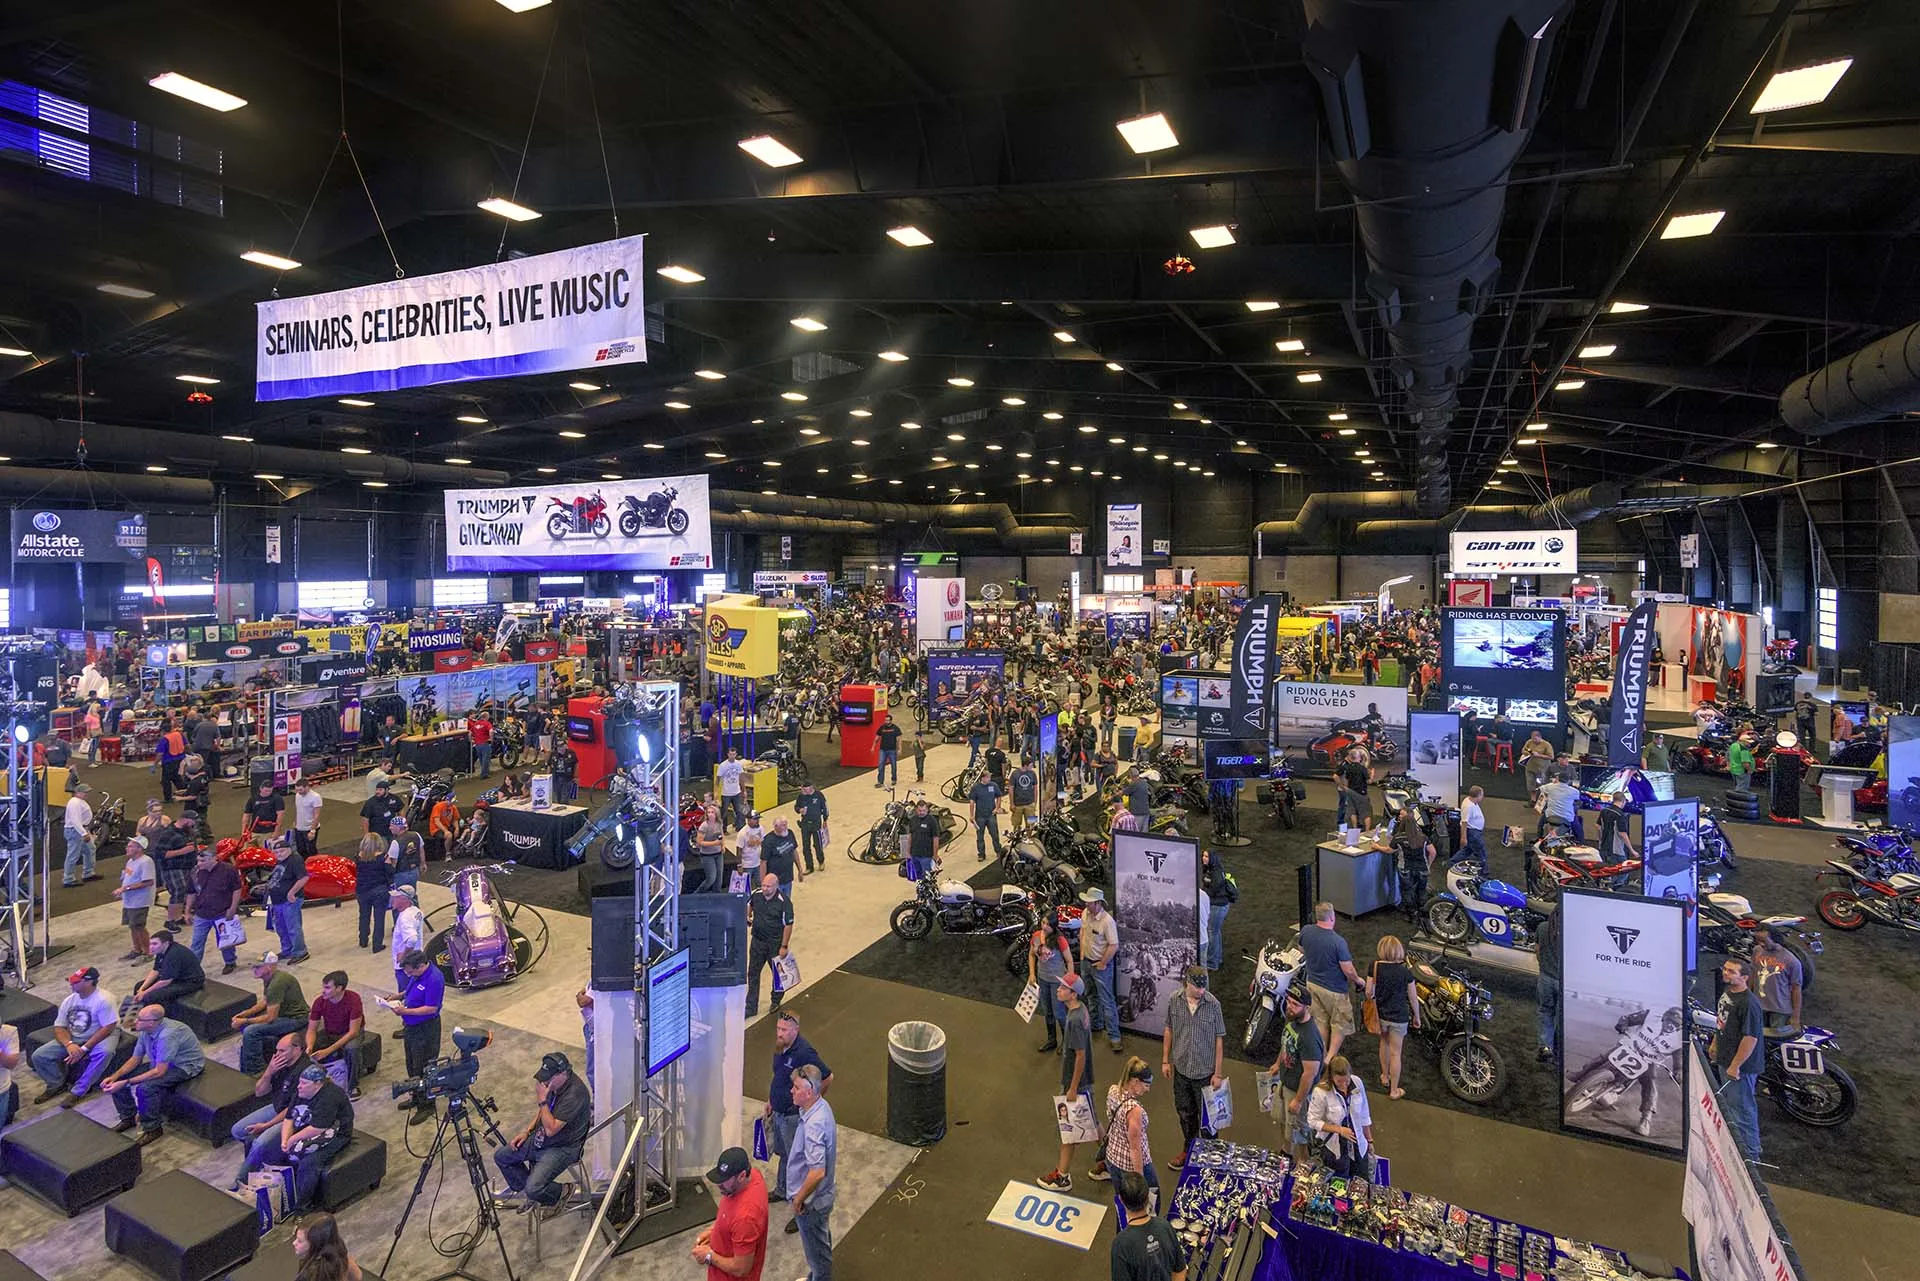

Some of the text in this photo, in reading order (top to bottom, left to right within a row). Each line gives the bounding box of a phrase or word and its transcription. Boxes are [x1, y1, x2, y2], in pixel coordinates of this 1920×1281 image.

[265, 268, 630, 356] SEMINARS, CELEBRITIES, LIVE MUSIC
[457, 499, 520, 520] TRIUMPH
[459, 522, 523, 546] GIVEAWAY
[17, 549, 84, 557] MOTORCYCLE
[1466, 541, 1536, 551] can-am
[1465, 561, 1562, 570] SPYDER
[944, 610, 963, 621] YAMAHA
[1448, 611, 1558, 620] RIDING HAS EVOLVED
[239, 630, 260, 638] EAR
[410, 633, 461, 649] HYOSUNG
[1241, 604, 1269, 705] TRIUMPH
[332, 667, 366, 677] venture
[1621, 613, 1649, 724] TRIUMPH
[37, 680, 55, 688] NG
[1286, 687, 1356, 698] RIDING HAS
[1293, 696, 1348, 707] EVOLVED
[503, 831, 541, 848] TRIUMPH
[1489, 918, 1500, 933] 9
[1596, 953, 1652, 968] FOR THE RIDE
[1786, 1047, 1819, 1070] 91
[1014, 1194, 1081, 1233] 300
